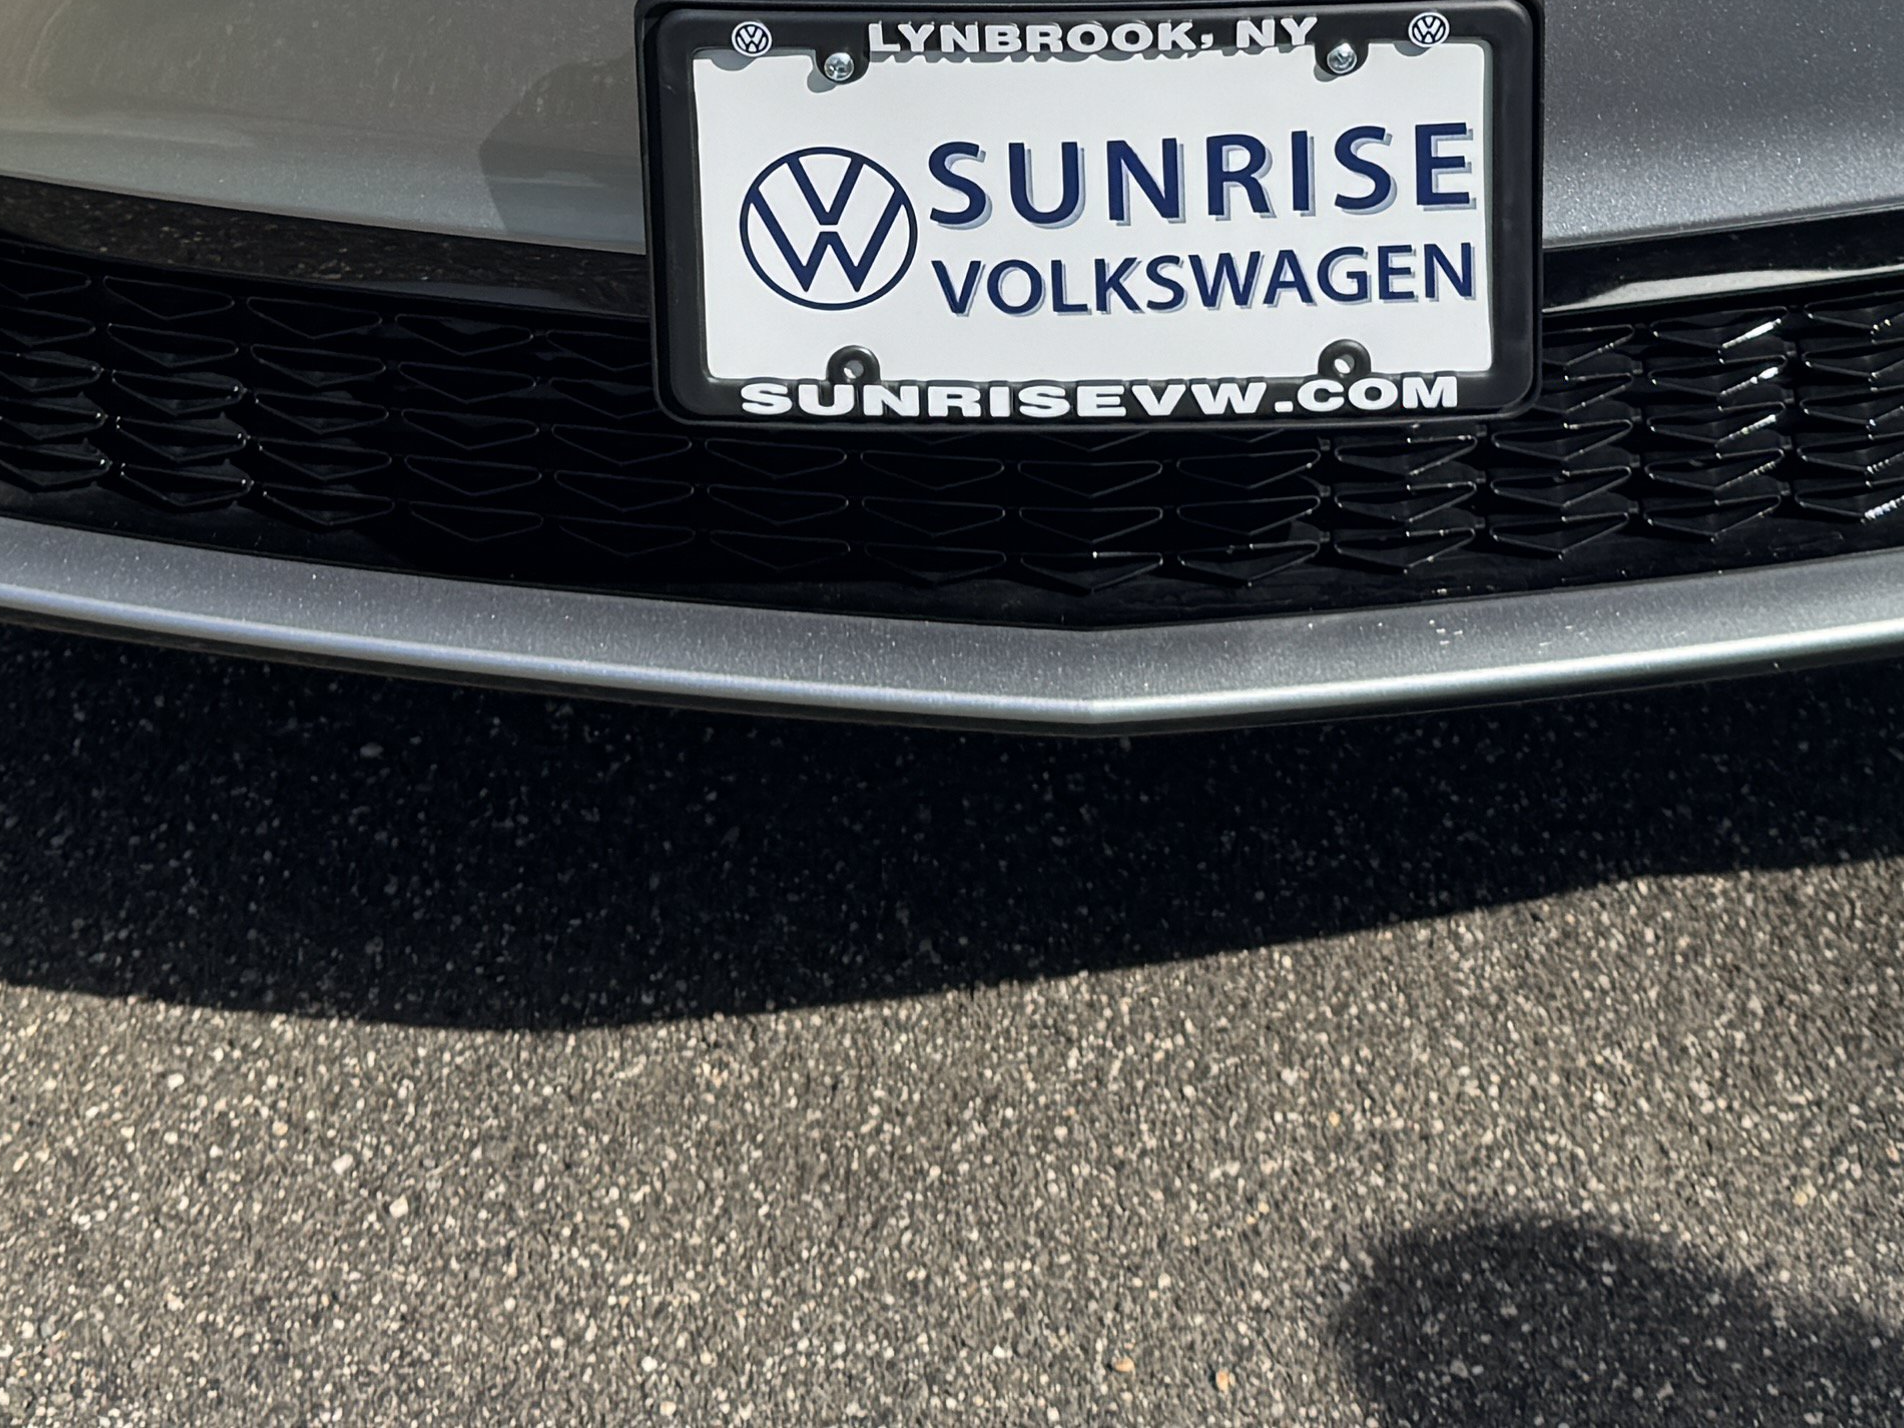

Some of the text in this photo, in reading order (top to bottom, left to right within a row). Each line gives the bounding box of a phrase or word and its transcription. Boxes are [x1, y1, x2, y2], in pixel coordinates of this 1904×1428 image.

[867, 15, 1319, 54] LYNBROOK, NY
[927, 121, 1476, 228] SUNRISE
[931, 241, 1475, 316] VOLKSWAGEN
[741, 375, 1459, 417] SUNRISEVW.COM
